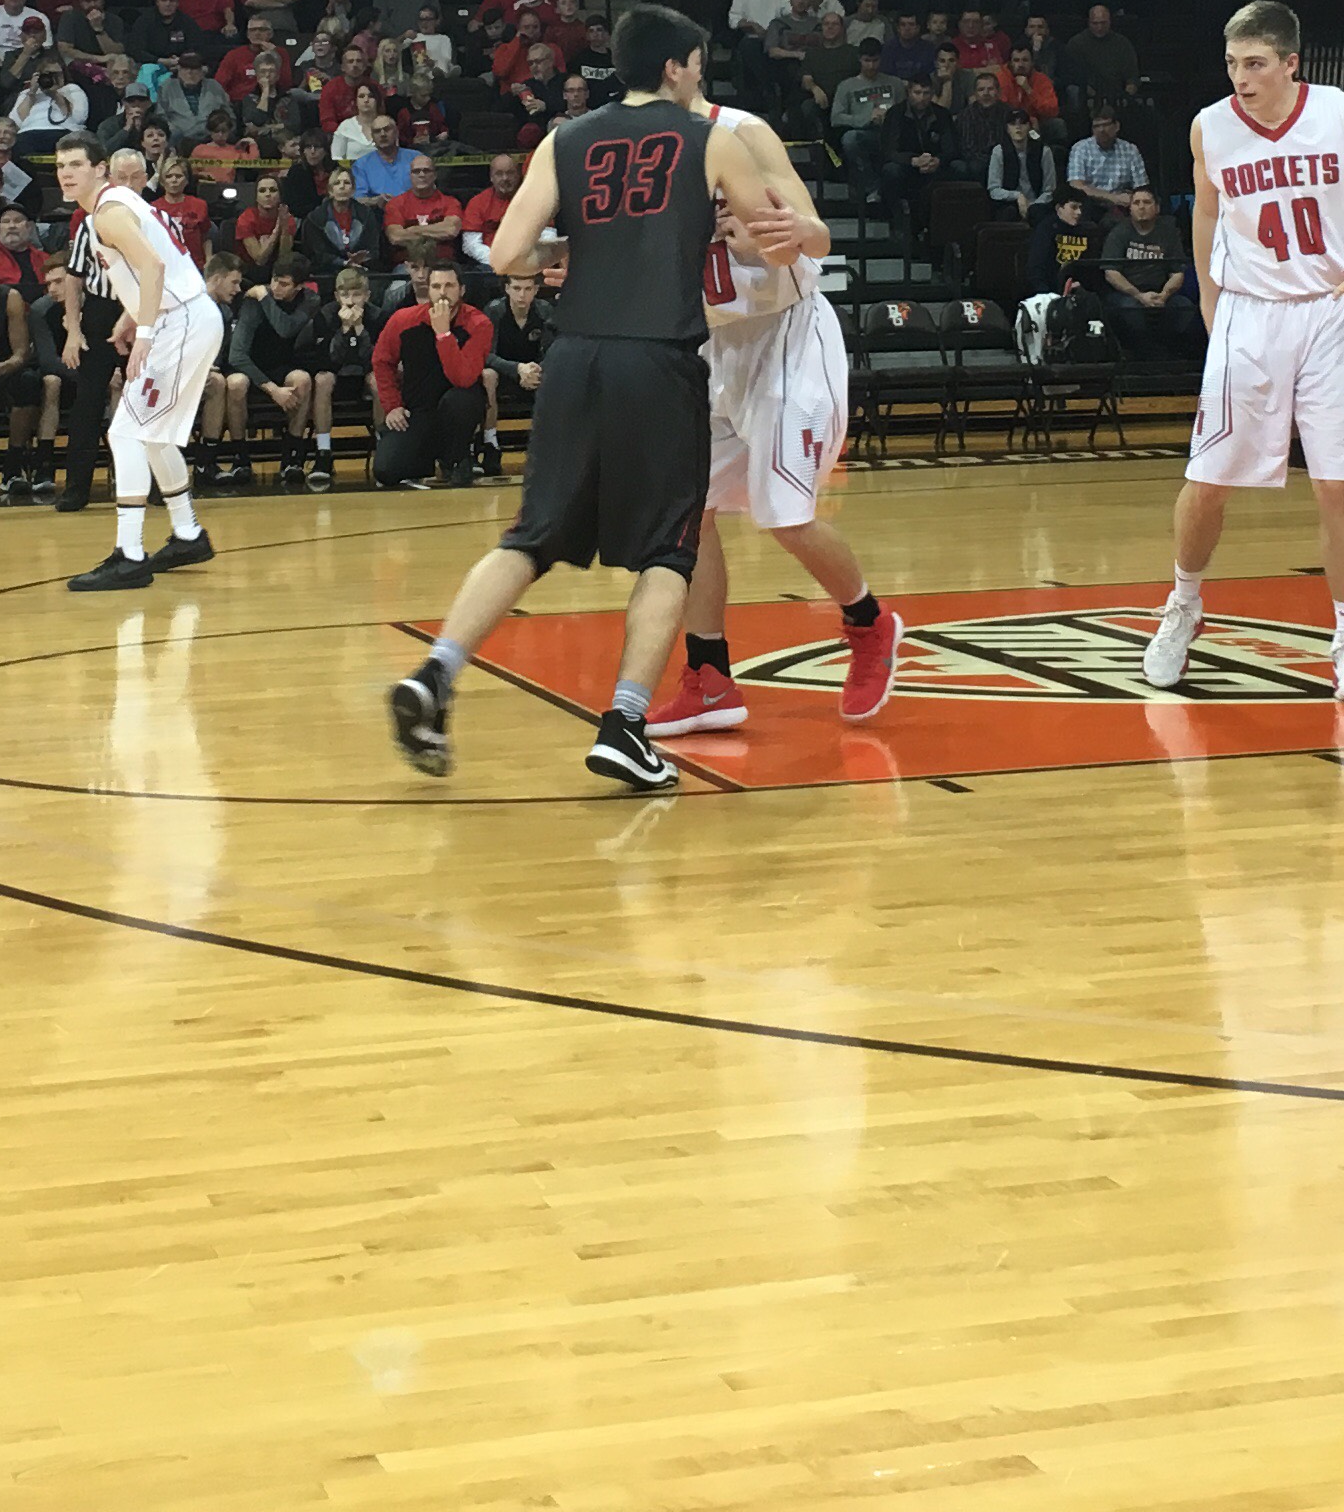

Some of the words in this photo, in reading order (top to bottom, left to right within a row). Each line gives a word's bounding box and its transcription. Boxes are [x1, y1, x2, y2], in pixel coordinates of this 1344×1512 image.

[581, 131, 685, 225] 33
[1220, 152, 1341, 199] ROCKETS
[1257, 196, 1328, 263] 40
